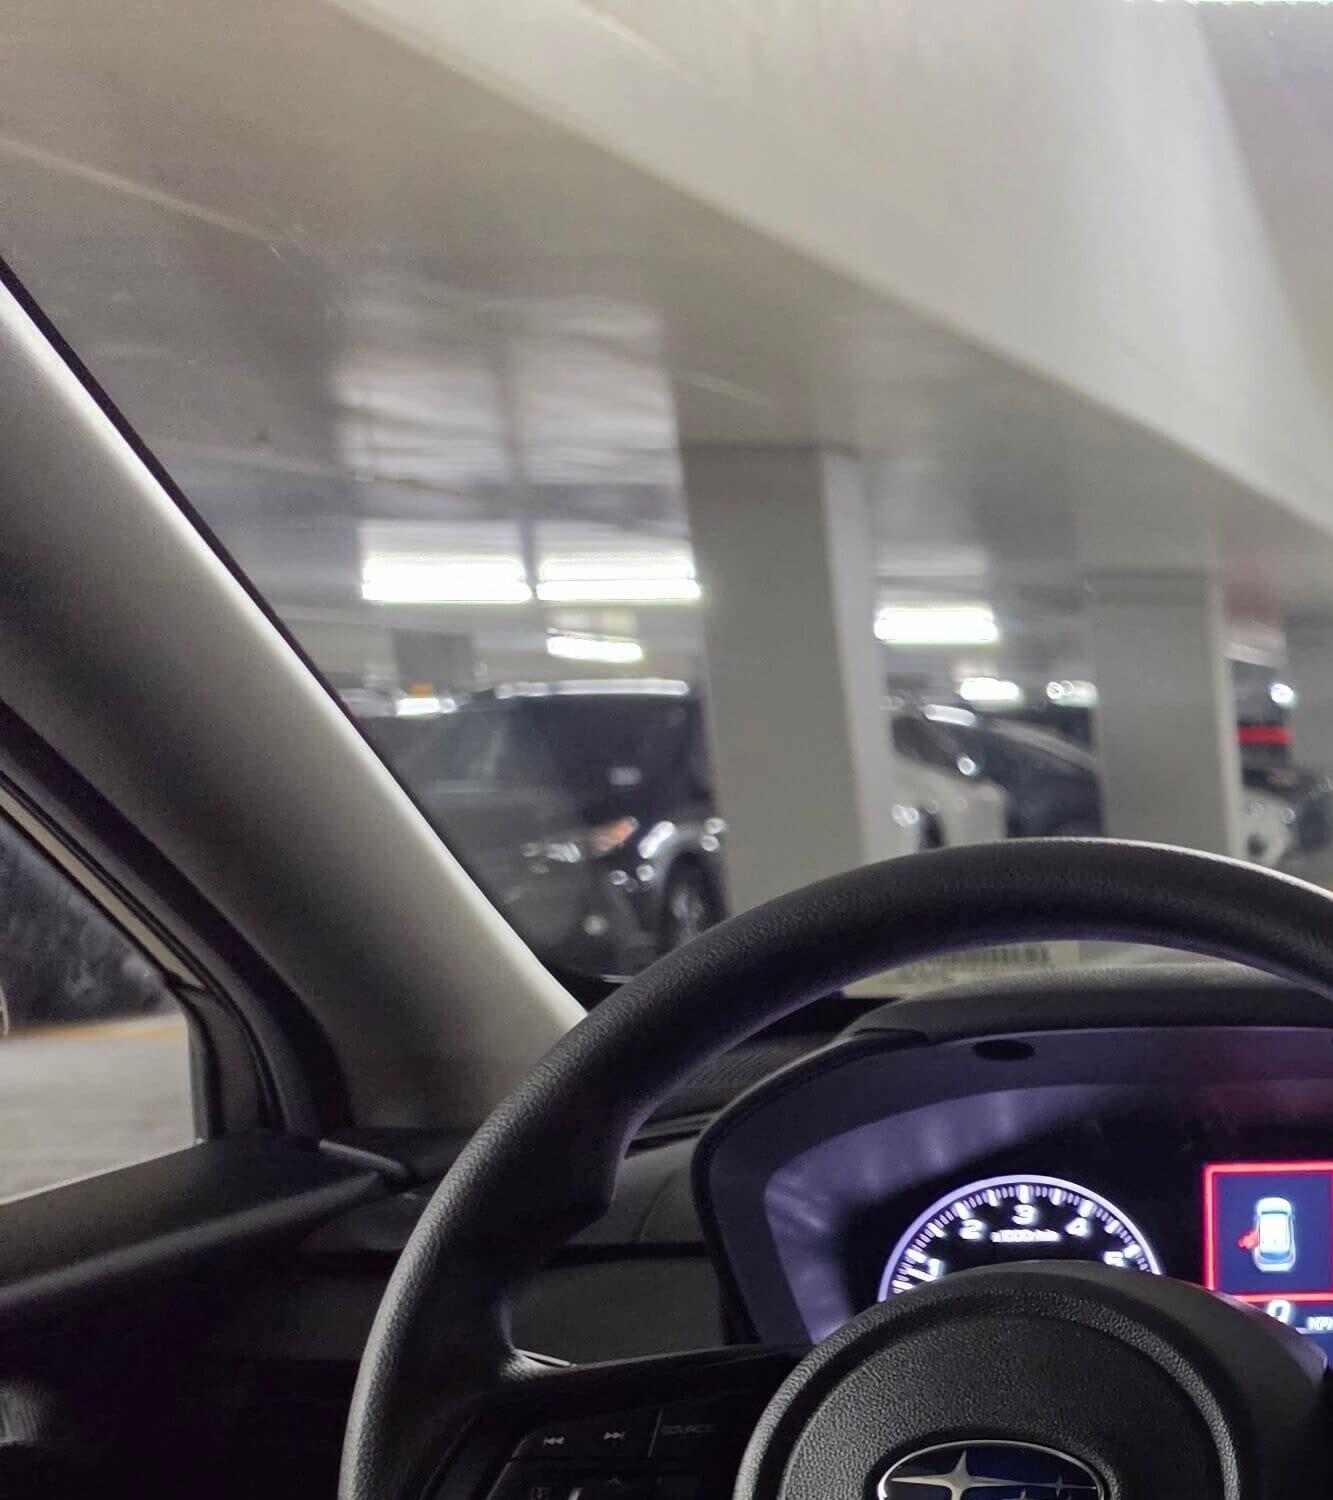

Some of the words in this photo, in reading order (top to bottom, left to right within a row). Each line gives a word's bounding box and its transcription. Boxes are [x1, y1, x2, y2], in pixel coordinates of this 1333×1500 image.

[1012, 1204, 1037, 1226] 3
[959, 1219, 985, 1241] 2
[1066, 1217, 1090, 1237] 4
